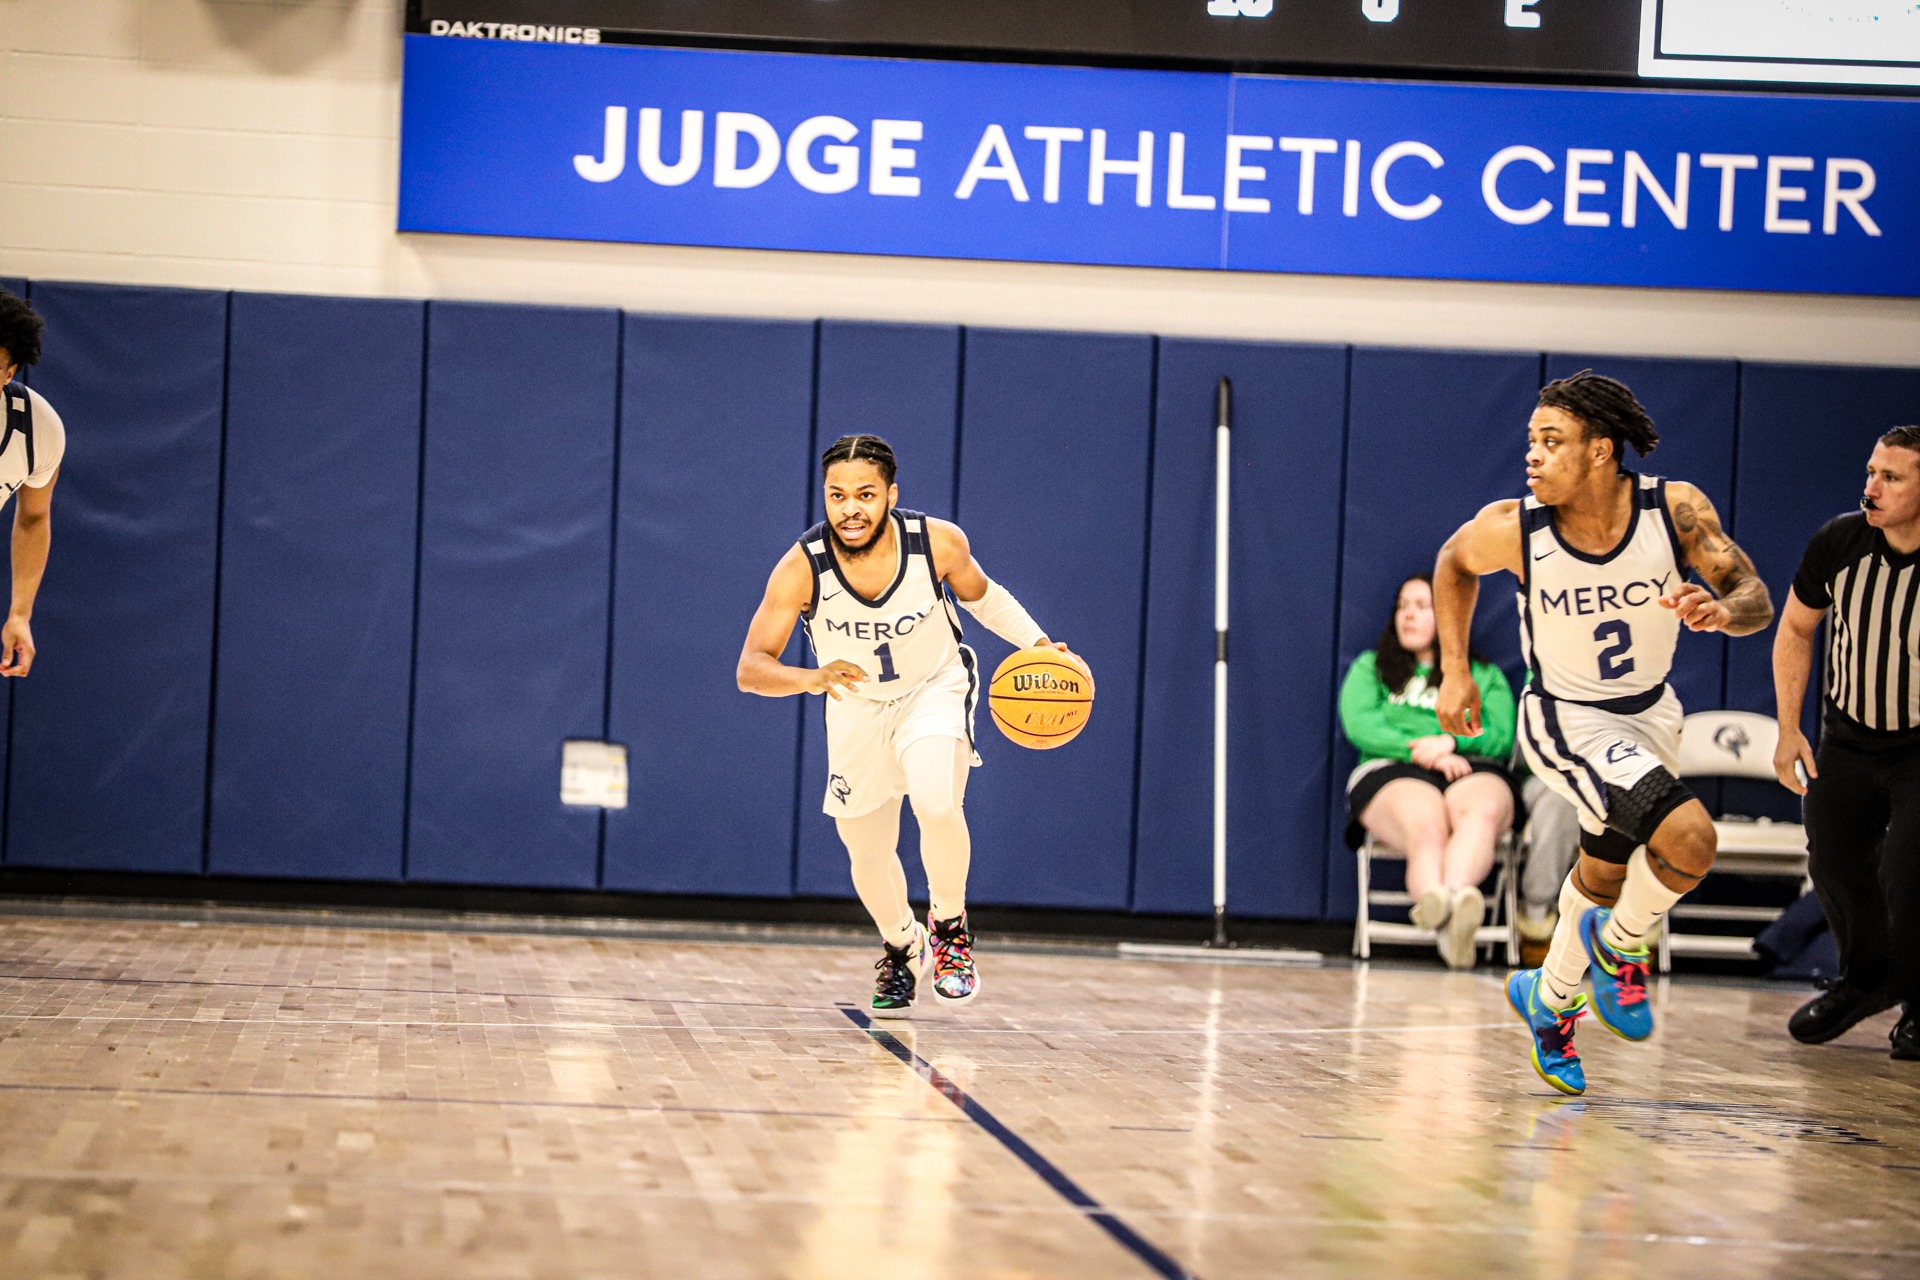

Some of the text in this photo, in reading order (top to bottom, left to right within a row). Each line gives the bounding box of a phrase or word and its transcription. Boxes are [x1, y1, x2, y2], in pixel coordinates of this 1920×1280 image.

[430, 19, 601, 45] DAKTRONICS
[573, 105, 1881, 236] JUDGE ATHLETIC CENTER
[1540, 570, 1671, 616] MERCY
[873, 642, 900, 683] 1
[1593, 618, 1635, 680] 2
[1013, 672, 1080, 694] Wilson
